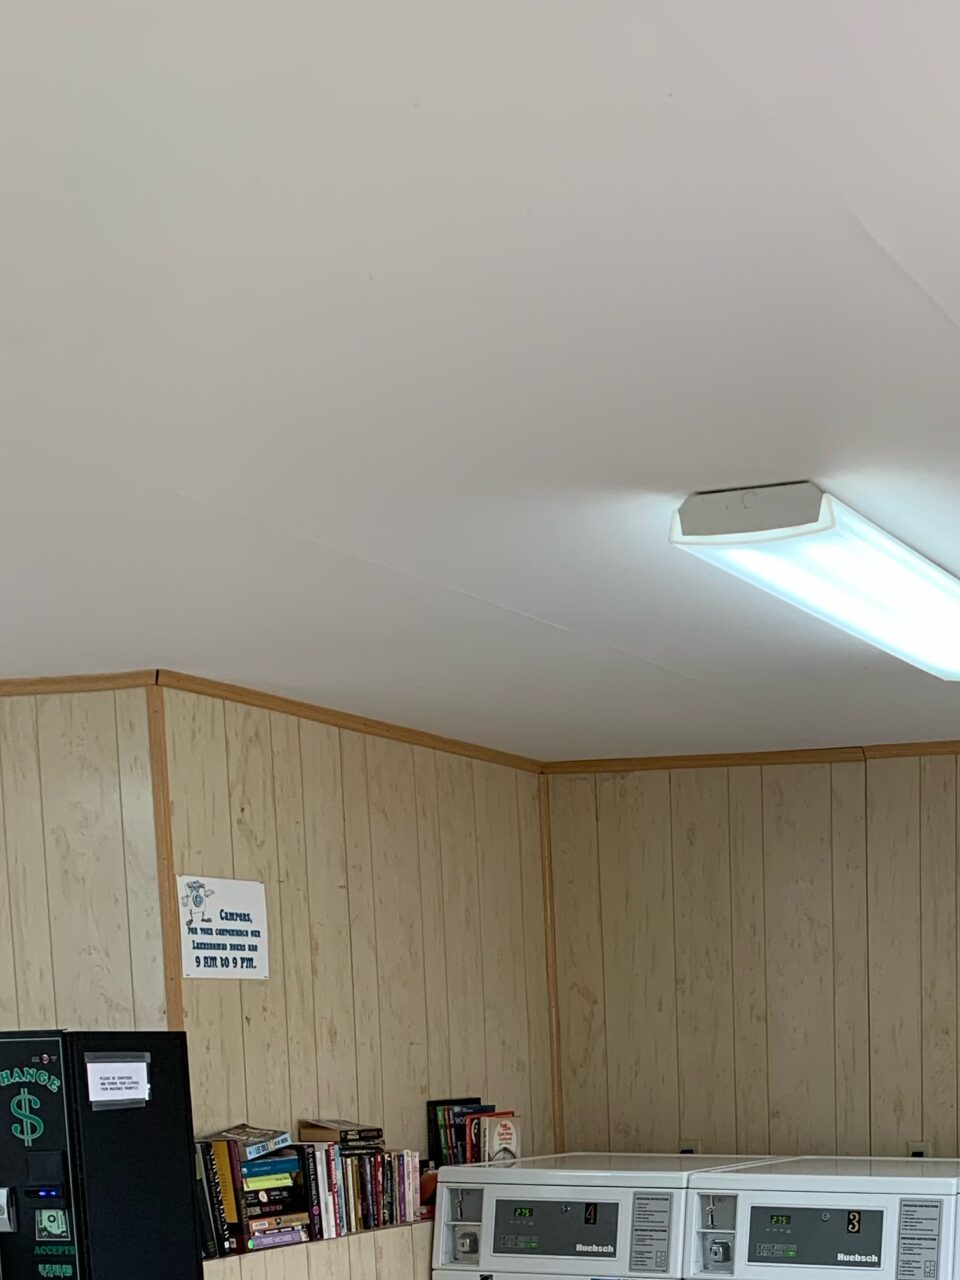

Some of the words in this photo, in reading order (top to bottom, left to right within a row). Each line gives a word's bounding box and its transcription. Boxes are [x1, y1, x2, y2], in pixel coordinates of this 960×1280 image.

[195, 955, 201, 968] 9
[232, 956, 238, 969] 9
[10, 1088, 44, 1147] $
[585, 1204, 595, 1224] 4
[849, 1212, 860, 1232] 3
[34, 1246, 76, 1255] ACCEPTS
[576, 1243, 614, 1254] Huebsch
[837, 1252, 878, 1263] Huebsch
